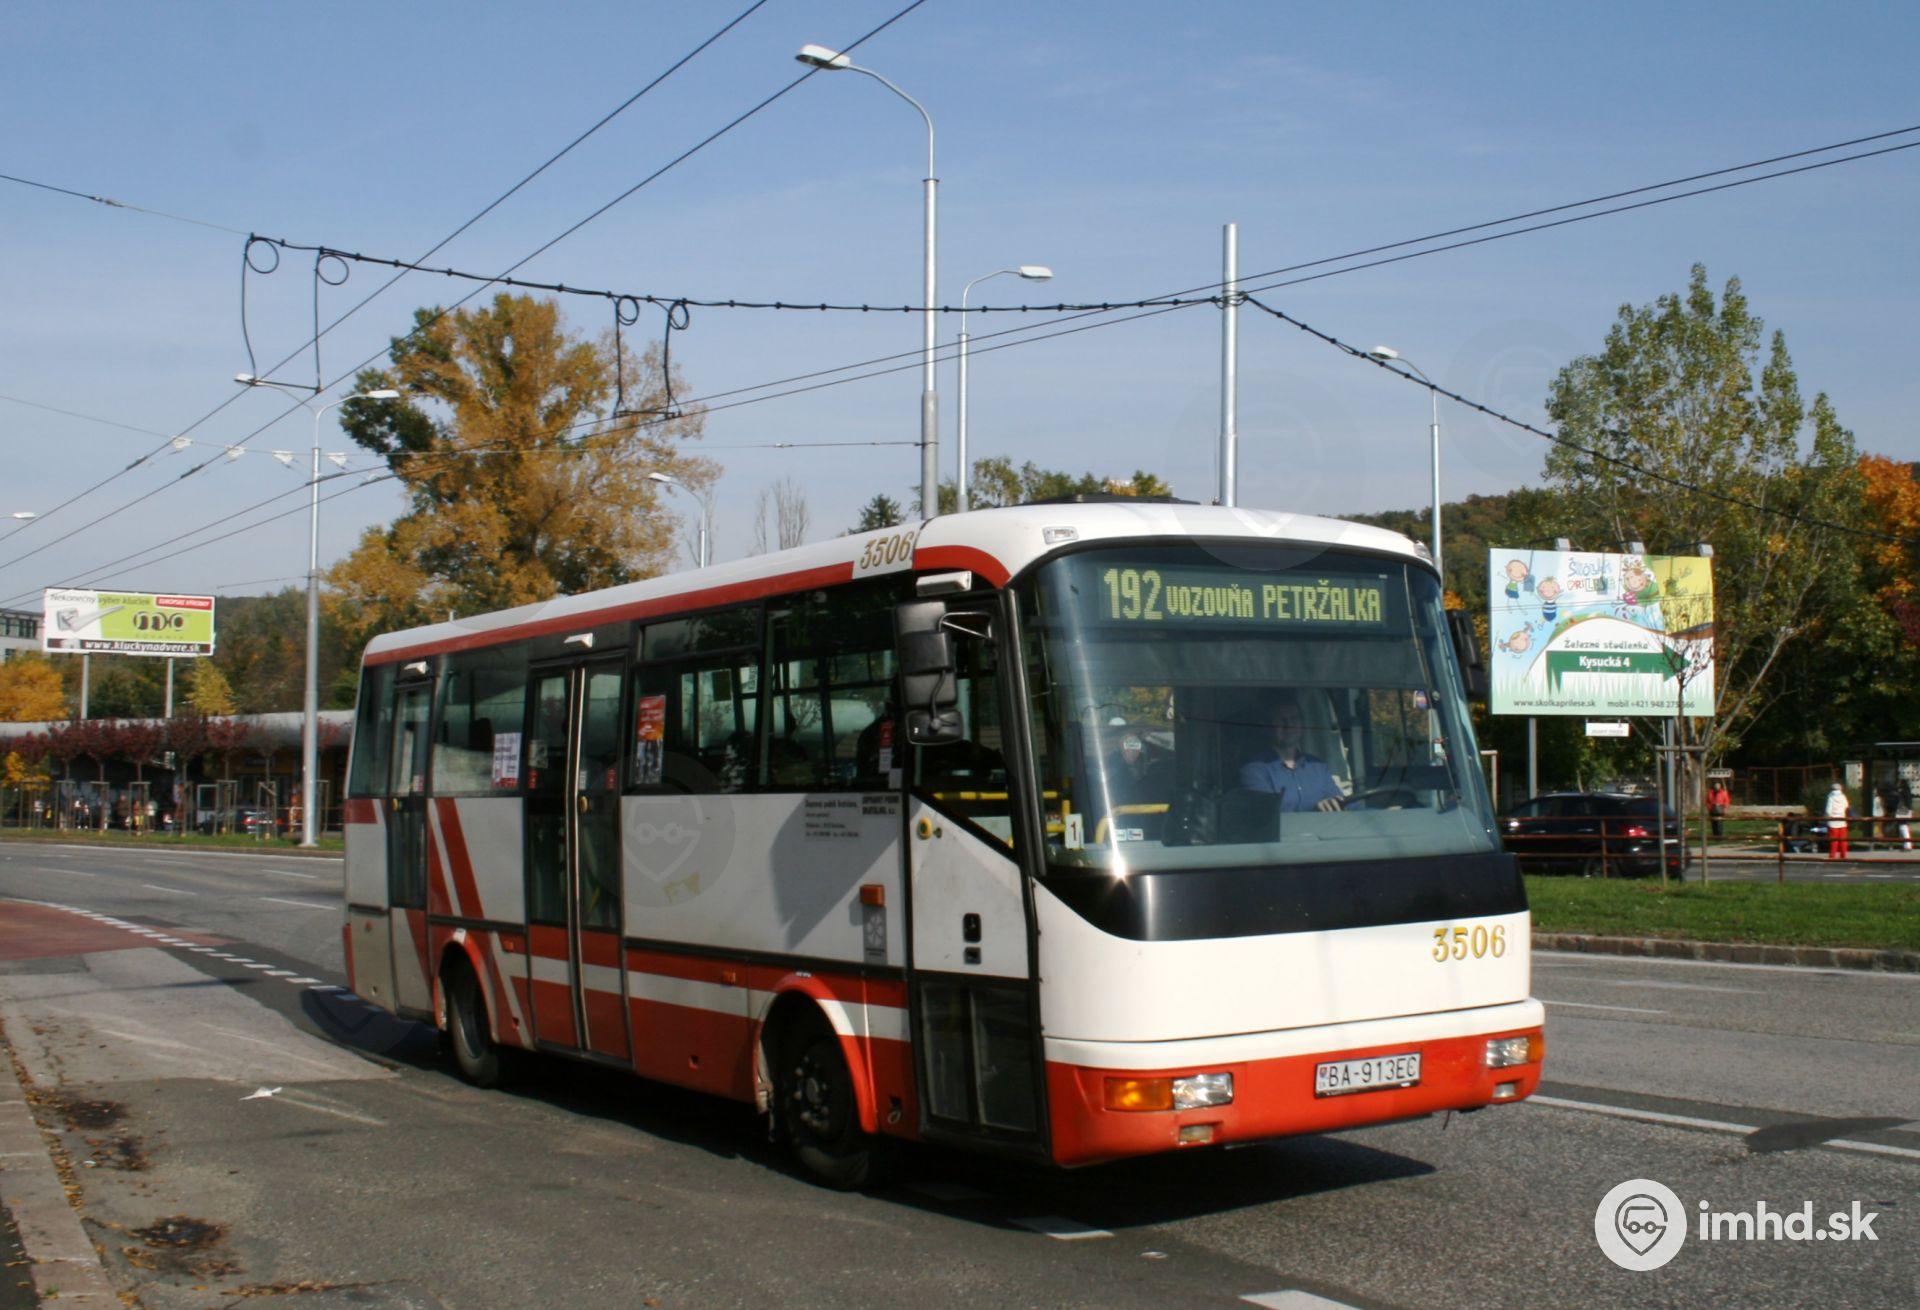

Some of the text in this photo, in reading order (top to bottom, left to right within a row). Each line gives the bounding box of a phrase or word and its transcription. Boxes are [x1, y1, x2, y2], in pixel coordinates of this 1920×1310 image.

[860, 530, 915, 569] 3506
[1104, 568, 1381, 621] 192 VOZOVŇA PETRŽALKA
[85, 641, 200, 653] www.kluckynadvere.sk
[1604, 640, 1649, 649] studienka
[1579, 656, 1630, 668] Kysucká 4
[1513, 699, 1596, 708] www.skolkaprilese.sk
[1607, 700, 1629, 708] mobil
[1431, 924, 1506, 963] 3506
[1328, 1056, 1417, 1087] BA-913EC
